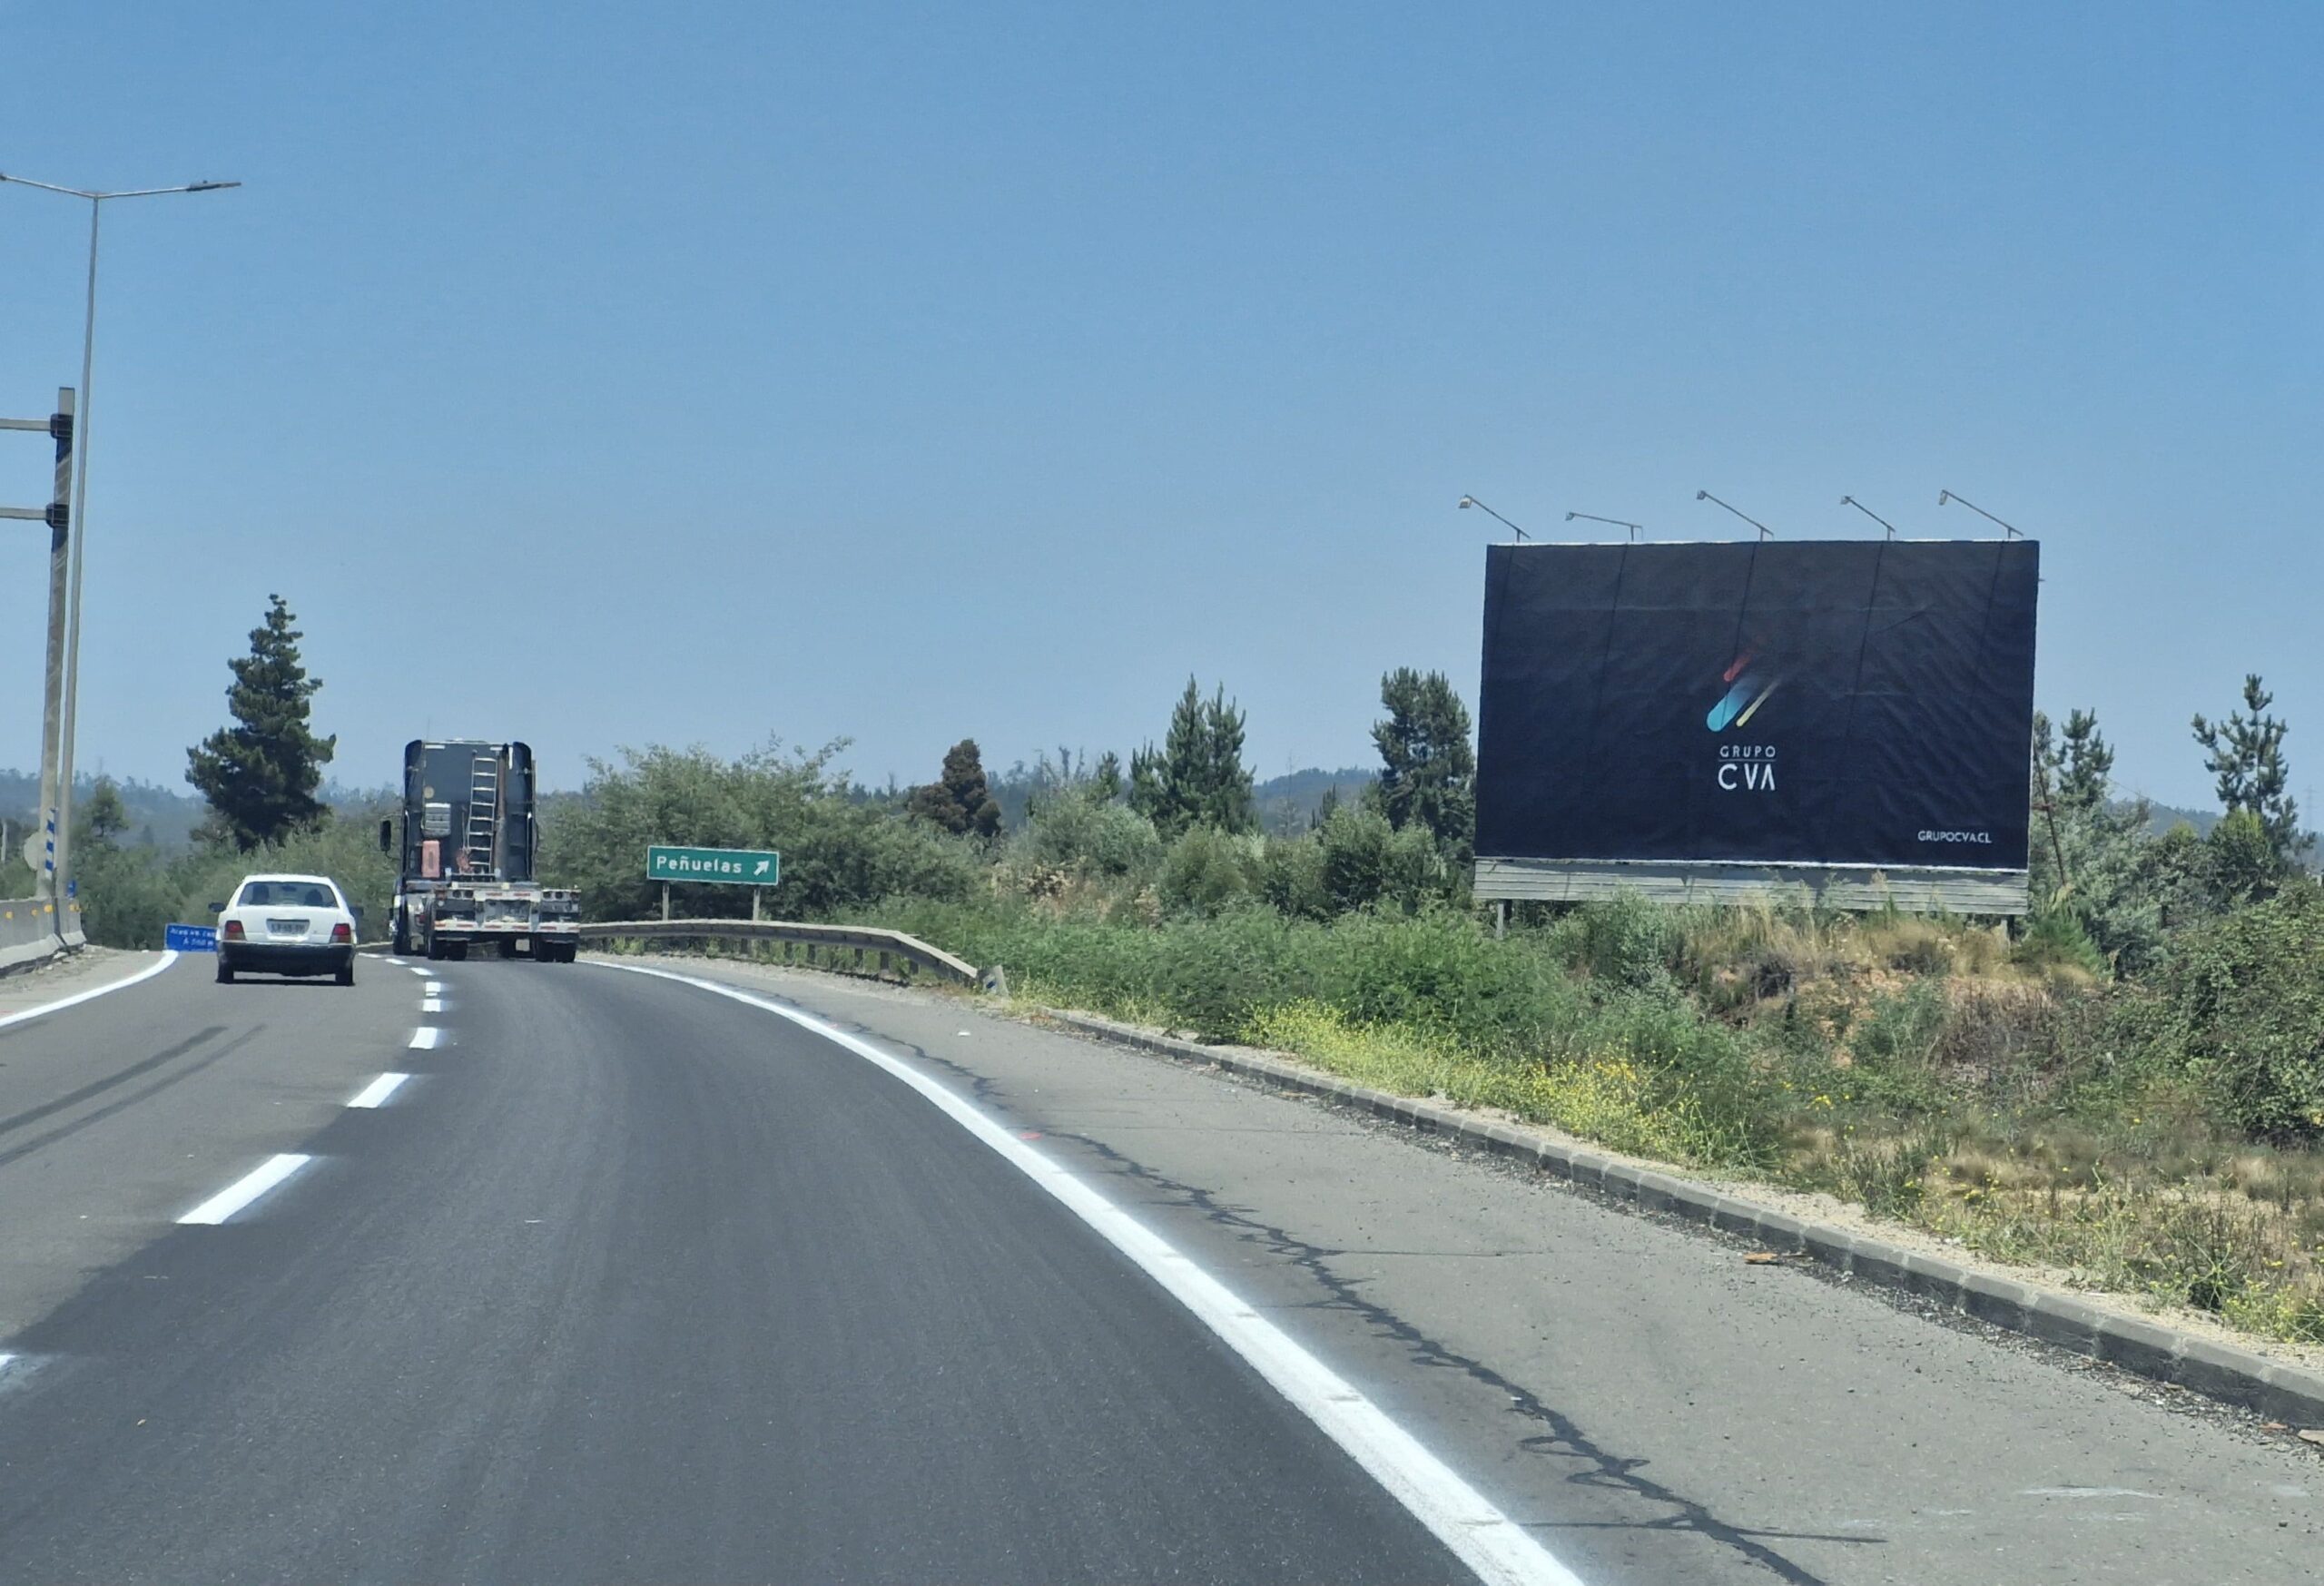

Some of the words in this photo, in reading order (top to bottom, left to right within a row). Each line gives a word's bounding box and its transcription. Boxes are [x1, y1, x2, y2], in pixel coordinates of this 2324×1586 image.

[1718, 744, 1777, 758] GRUPO
[1718, 763, 1776, 791] CVA
[655, 854, 743, 873] Peñuelas
